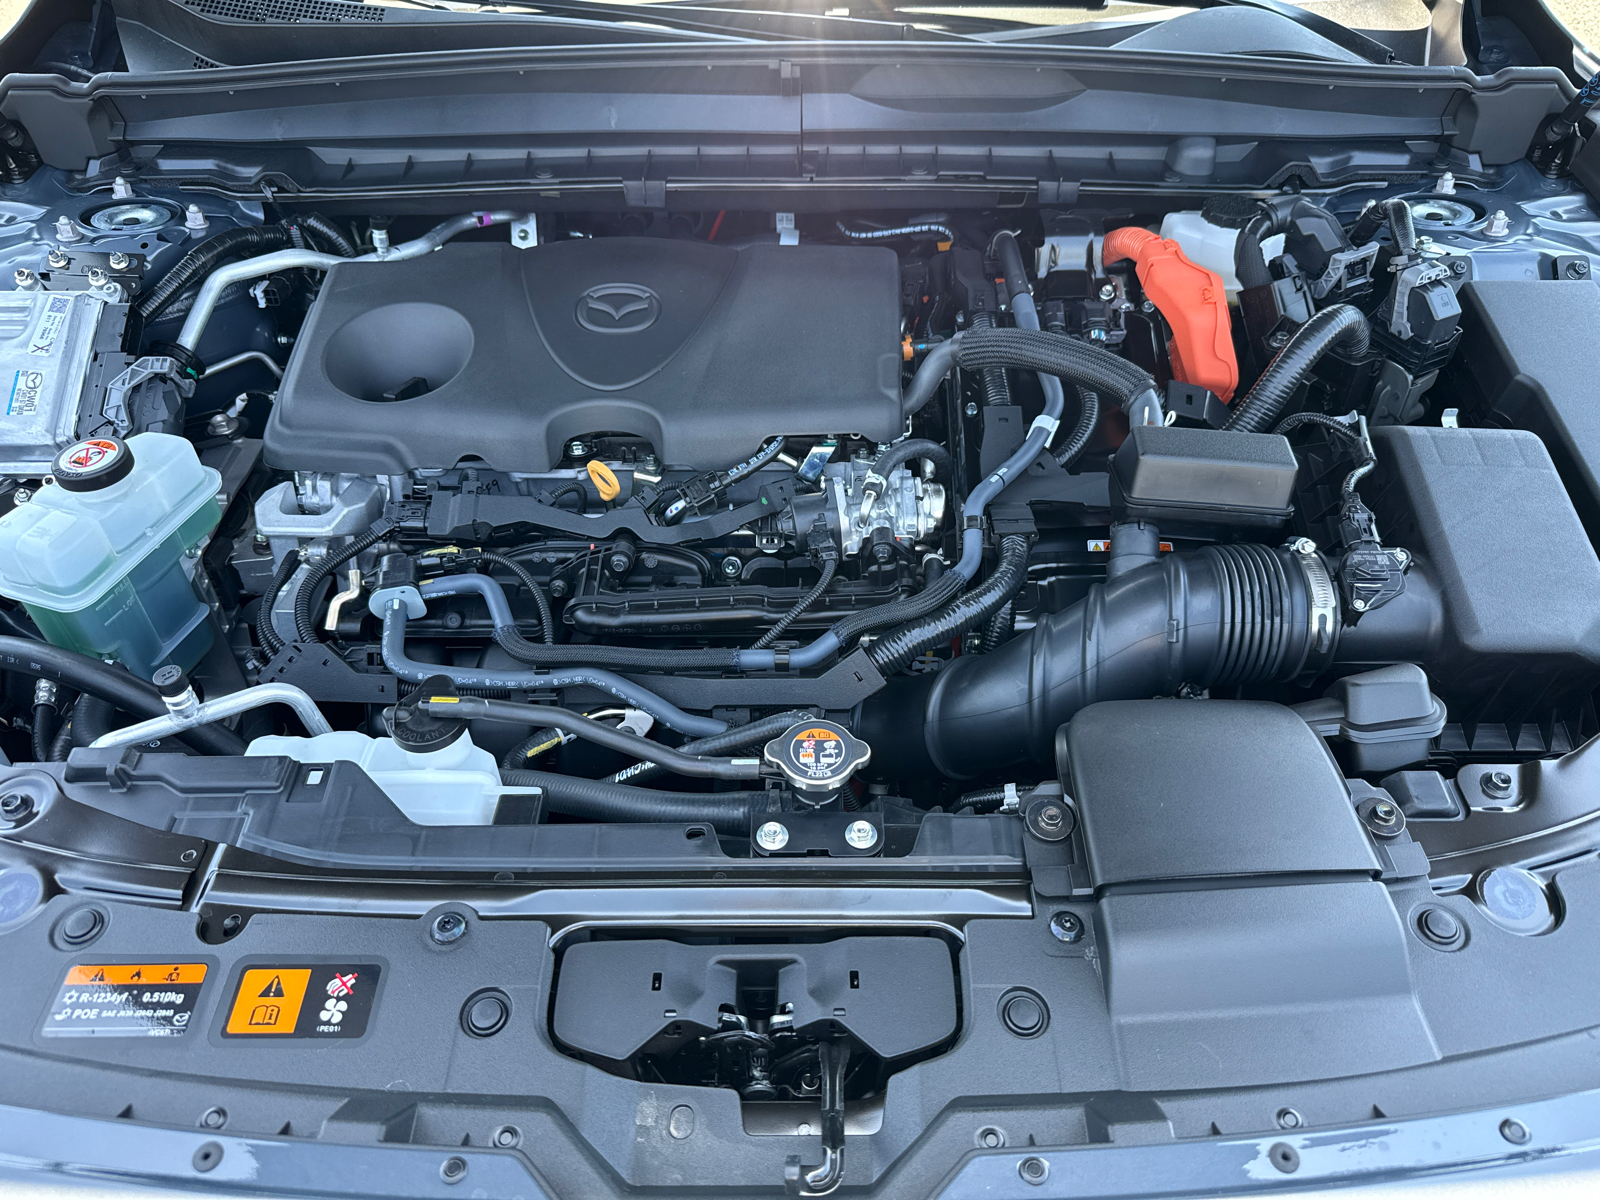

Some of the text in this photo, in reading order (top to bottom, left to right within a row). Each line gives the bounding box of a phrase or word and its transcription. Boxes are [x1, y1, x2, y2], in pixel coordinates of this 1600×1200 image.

[24, 389, 38, 412] CW01
[398, 727, 447, 741] COOLANT
[79, 992, 185, 1004] R-1234yf 0.510kg
[72, 1008, 99, 1019] POE
